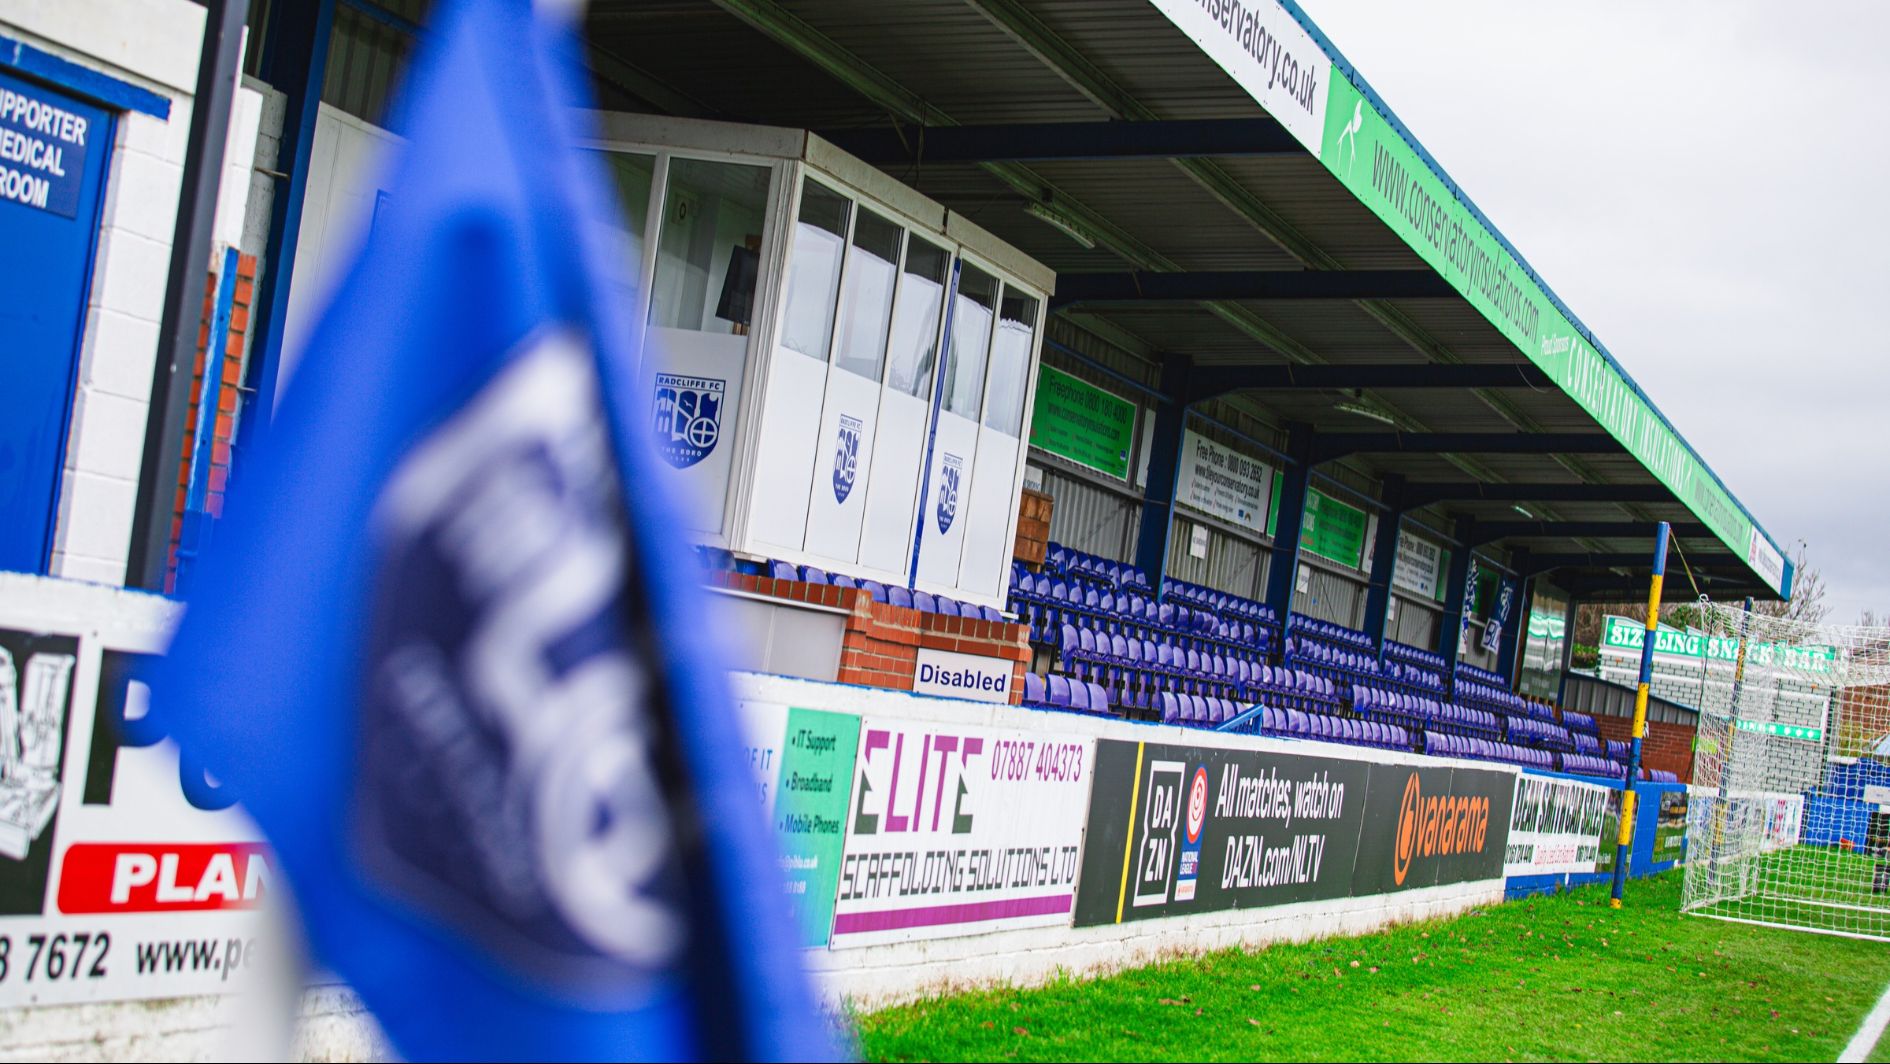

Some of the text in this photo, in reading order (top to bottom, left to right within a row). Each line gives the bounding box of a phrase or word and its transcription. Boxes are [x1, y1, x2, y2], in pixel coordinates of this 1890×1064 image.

[0, 127, 65, 177] EDICAL
[1372, 139, 1540, 345] www.conservatoryinsulations.com
[658, 376, 720, 390] RADCLIFFE FC
[1567, 336, 1638, 449] CONSERVATORY
[1196, 439, 1209, 461] Free
[1610, 626, 1699, 654] SIZLING
[1708, 638, 1771, 664] SNCK
[920, 664, 1006, 692] Disabled
[796, 730, 837, 757] IT Support
[790, 771, 833, 793] Broadband
[853, 730, 1083, 836] ELITE 07887 404373
[1215, 763, 1344, 829] All matches, watch on
[1511, 778, 1543, 832] DEAN
[1537, 782, 1571, 834] SMITH
[1580, 788, 1606, 837] SALES
[784, 814, 840, 834] Mobile Phones
[1417, 796, 1490, 858] vanarama
[841, 850, 966, 900] SCAFFOLDING
[966, 847, 1050, 892] SOLUTIONS
[1050, 846, 1078, 885] LTD
[1221, 834, 1326, 889] DAZN.com/NLTV
[27, 930, 111, 982] 7672
